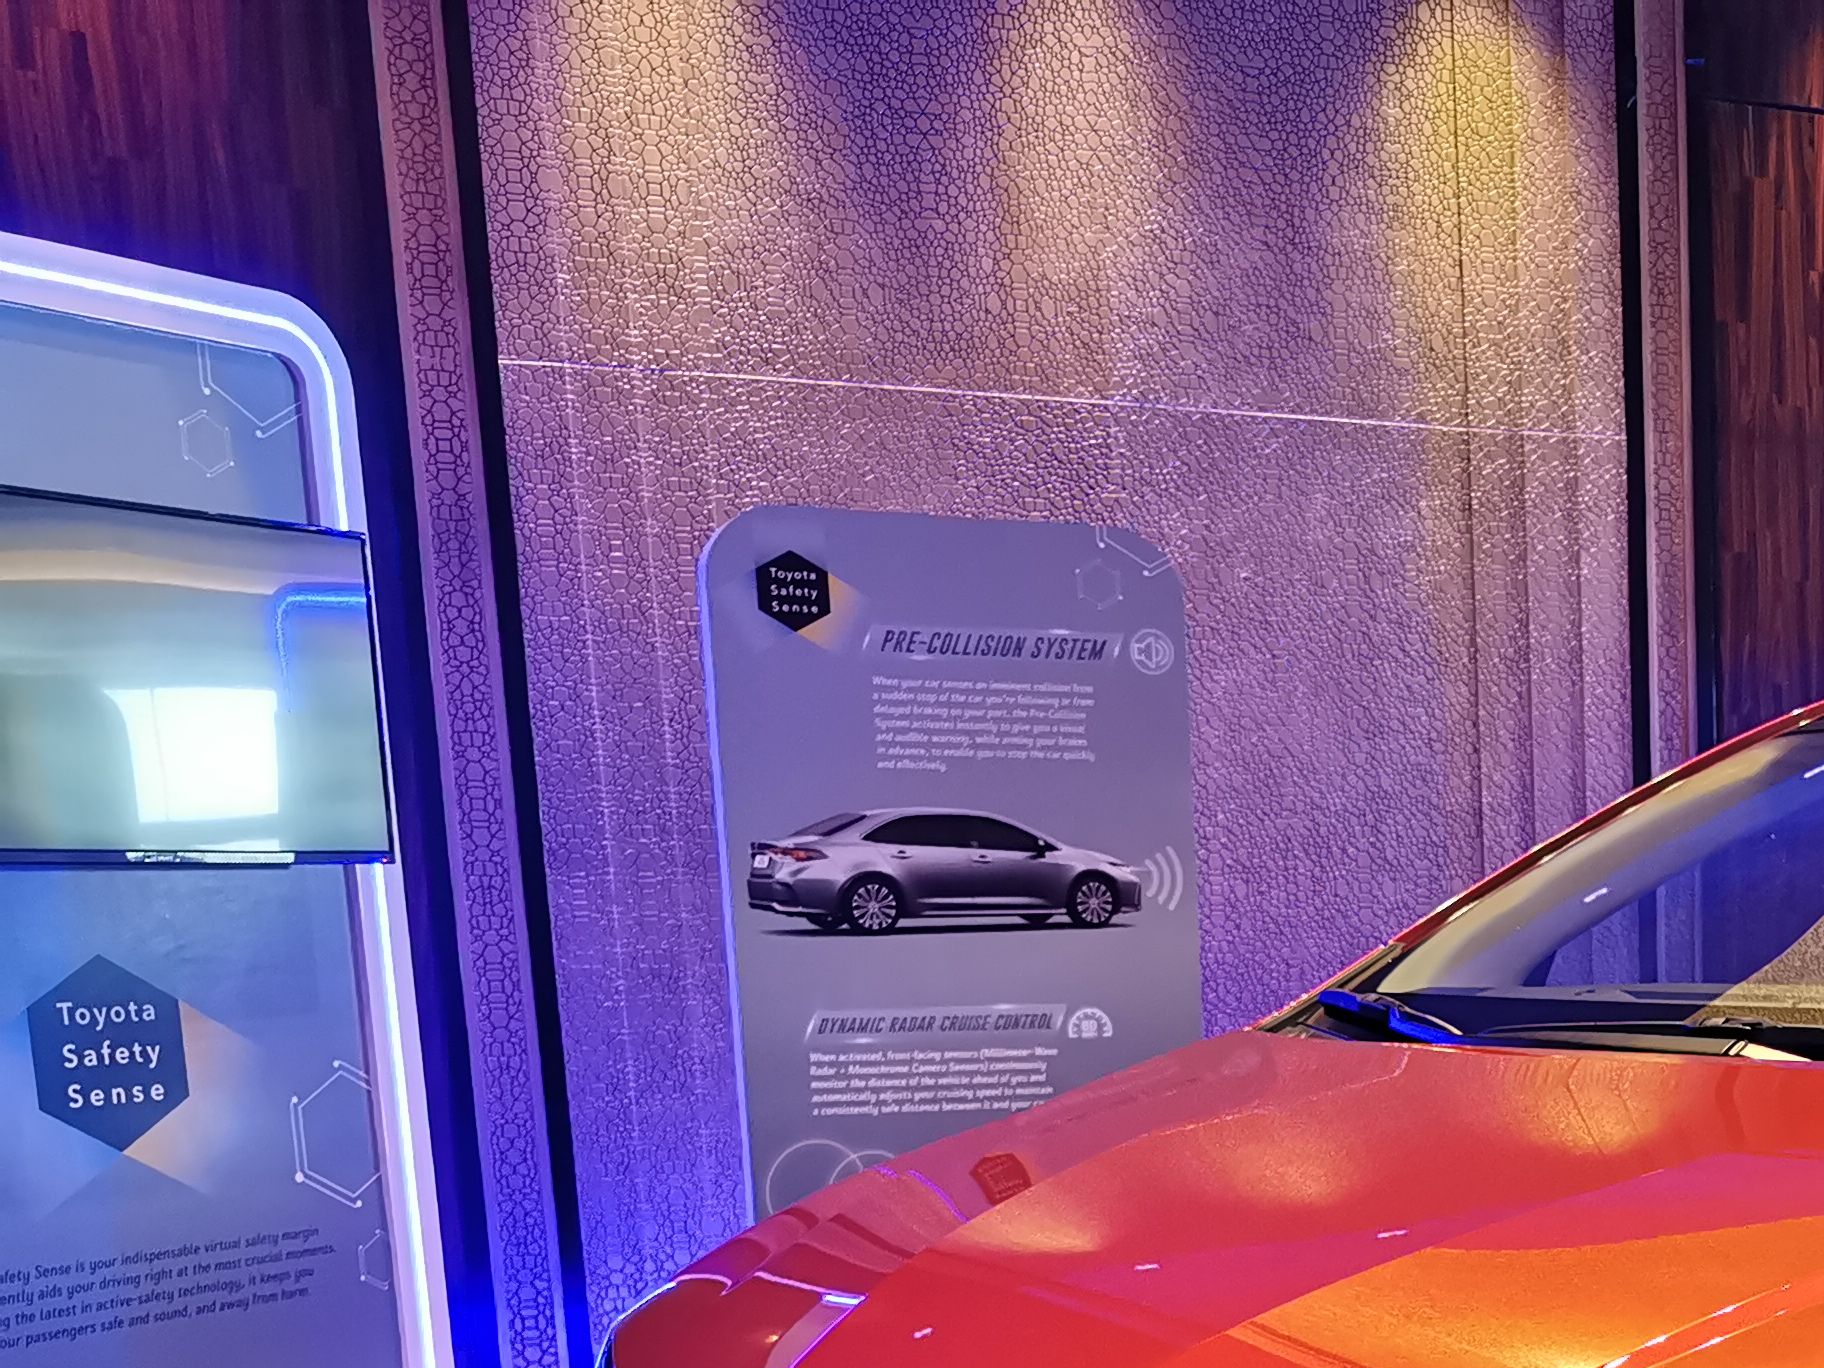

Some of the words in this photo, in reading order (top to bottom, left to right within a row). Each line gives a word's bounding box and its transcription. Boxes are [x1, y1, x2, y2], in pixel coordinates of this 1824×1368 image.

[769, 567, 817, 582] Toyota
[770, 584, 818, 600] Safety
[771, 600, 819, 614] Sense
[881, 629, 1027, 658] PRE-COLLISION
[1030, 636, 1107, 661] SYSTEM
[55, 1000, 156, 1030] Toyota
[817, 1016, 883, 1035] DYNAMIC
[888, 1015, 936, 1033] RADAR
[940, 1014, 991, 1032] CRUISE
[994, 1013, 1053, 1031] CONTROL
[62, 1040, 162, 1069] Safety
[68, 1083, 165, 1109] Sense
[0, 1269, 30, 1286] afety
[35, 1264, 72, 1280] Sense
[75, 1258, 85, 1273] is
[89, 1257, 118, 1275] your
[120, 1243, 201, 1265] indispensable
[203, 1236, 241, 1253] virtual
[0, 1288, 34, 1306] ently
[38, 1284, 63, 1300] aids
[66, 1282, 96, 1300] your
[99, 1273, 141, 1289] driving
[144, 1268, 173, 1286] right
[176, 1265, 188, 1278] at
[193, 1261, 212, 1276] the
[15, 1311, 36, 1326] the
[40, 1304, 76, 1321] latest
[81, 1300, 92, 1314] in
[178, 1278, 245, 1298] technology,
[248, 1272, 256, 1286] it
[0, 1336, 22, 1349] our
[26, 1322, 97, 1348] passengers
[100, 1315, 125, 1332] safe
[128, 1311, 150, 1329] and
[153, 1305, 192, 1321] sound,
[195, 1300, 217, 1316] and
